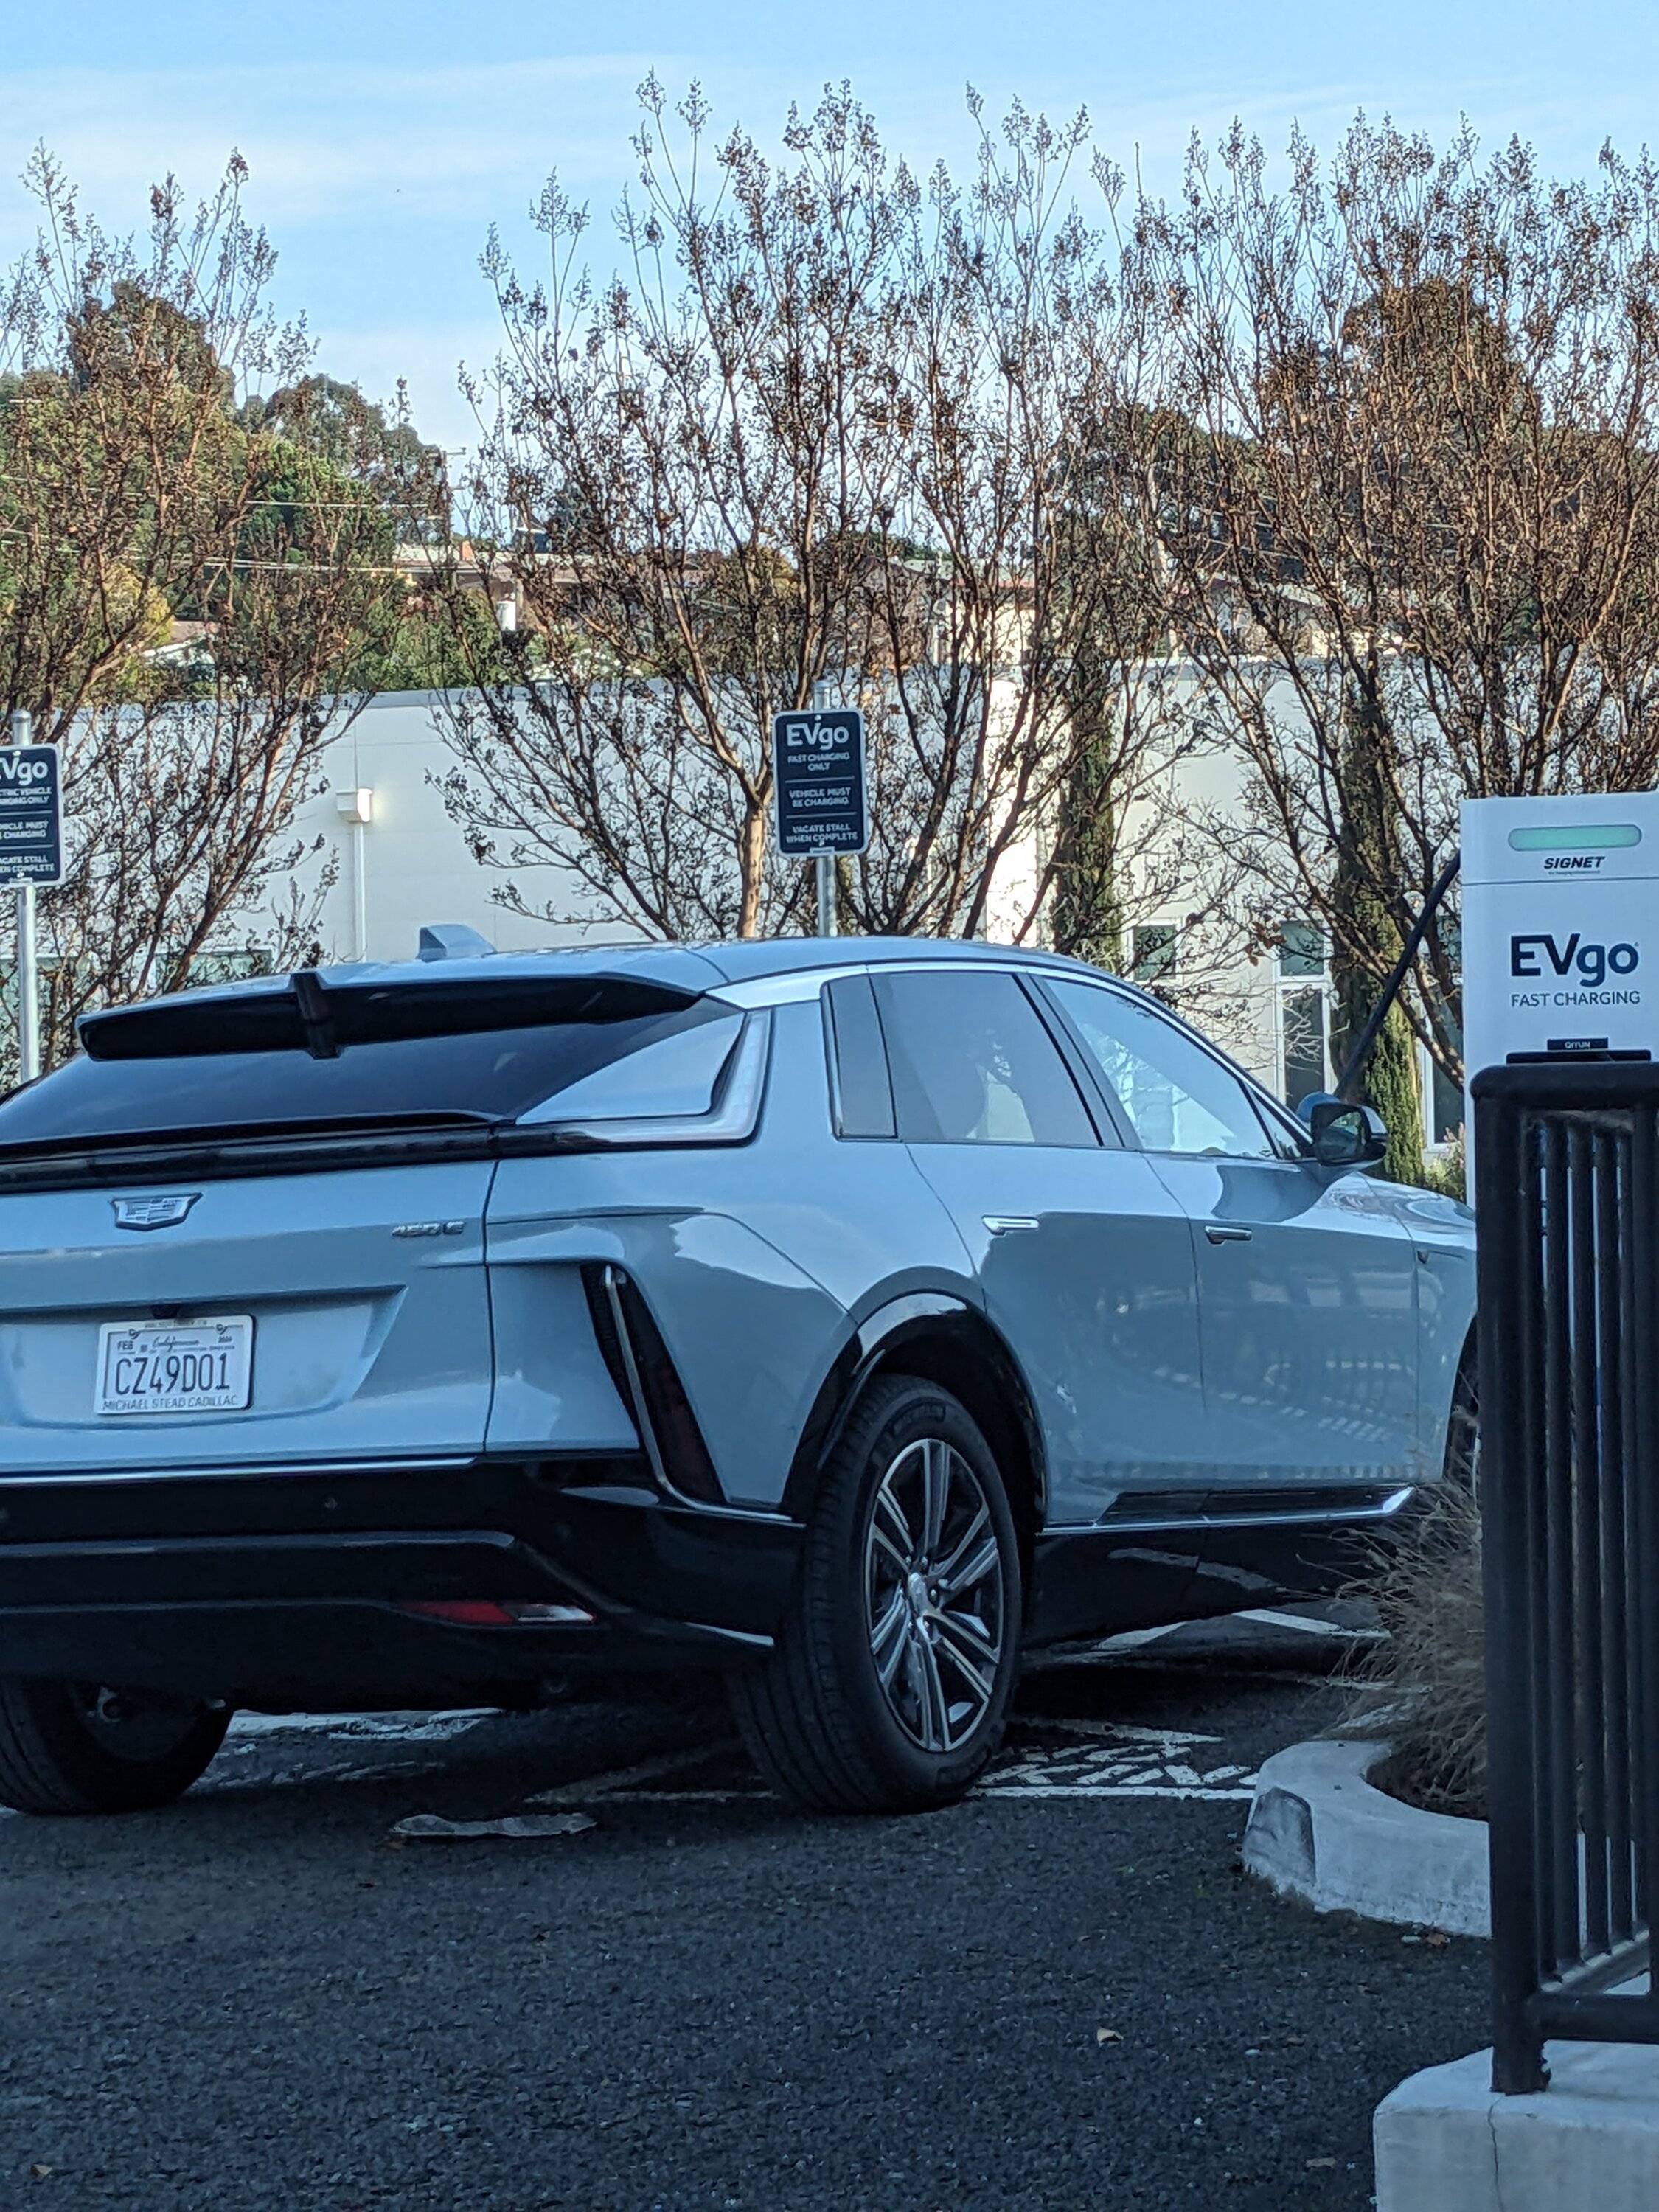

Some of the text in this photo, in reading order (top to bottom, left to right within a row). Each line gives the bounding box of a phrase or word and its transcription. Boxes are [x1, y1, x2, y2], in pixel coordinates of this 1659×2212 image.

[786, 723, 849, 750] EVgo
[807, 752, 850, 762] CHARGING
[0, 757, 49, 786] Vgo
[807, 762, 830, 771] ONLY
[789, 787, 851, 798] VEHICLE MUST
[804, 796, 850, 807] CHARGING
[793, 825, 825, 834] VACATE
[786, 832, 858, 844] WHEN COMPLETE
[1543, 856, 1605, 869] SIGNET
[1511, 933, 1639, 988] EVgo
[1511, 990, 1641, 1007] FAST CHARGING
[115, 1352, 230, 1396] CZ49D01
[102, 1394, 237, 1411] MICHAEL STEAD CADILLAC
